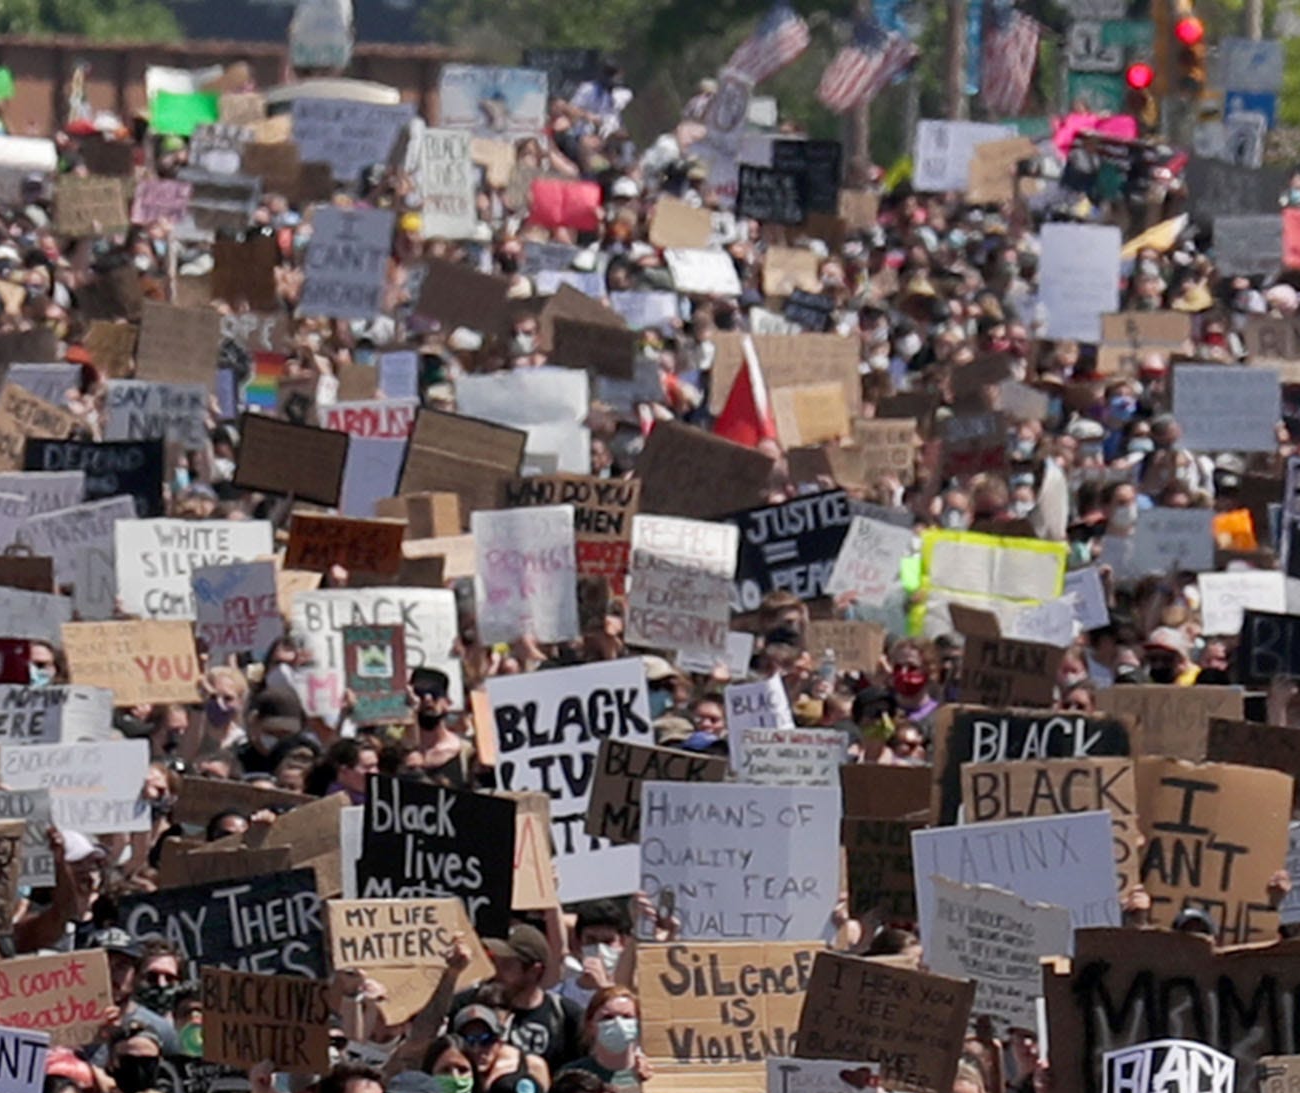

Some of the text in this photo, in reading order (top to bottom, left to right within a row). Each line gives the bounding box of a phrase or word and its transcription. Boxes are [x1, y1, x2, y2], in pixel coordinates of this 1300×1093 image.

[154, 526, 231, 550] WHITE
[745, 491, 850, 542] JUSTICE
[200, 622, 259, 646] STATE
[305, 600, 419, 631] BLACK
[135, 656, 195, 681] YOU
[494, 689, 649, 752] BLACK
[971, 719, 1101, 763] BLACK
[605, 740, 710, 783] BLACK
[372, 776, 459, 837] black
[647, 790, 815, 829] HUMANS OF
[971, 768, 1133, 821] BLACK
[1155, 776, 1221, 836] I
[403, 840, 482, 889] lives
[642, 837, 753, 868] QUALITY
[932, 828, 1082, 869] LATINX
[743, 874, 821, 900] FEAR
[212, 885, 325, 949] THEIR
[345, 905, 439, 927] MY LIFE
[221, 1021, 310, 1066] MATTER
